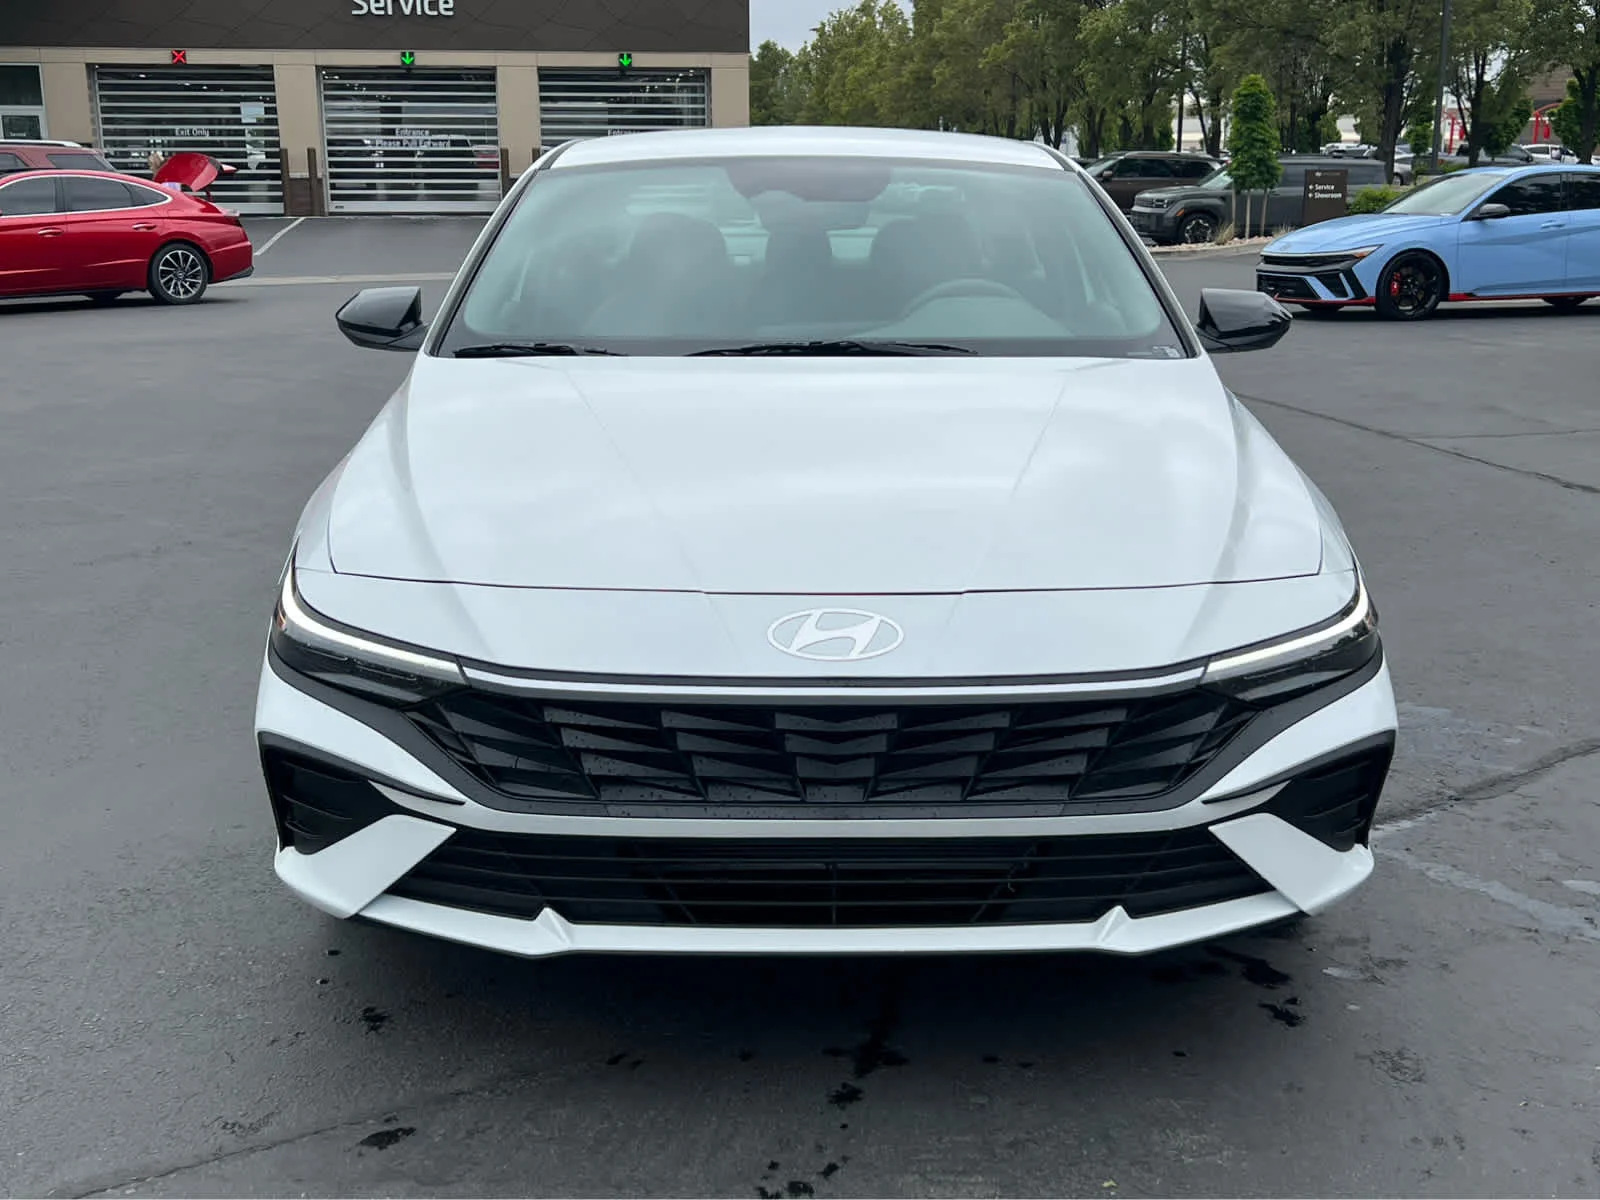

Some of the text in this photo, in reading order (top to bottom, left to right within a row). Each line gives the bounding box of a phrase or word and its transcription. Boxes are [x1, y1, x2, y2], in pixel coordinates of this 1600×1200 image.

[351, 0, 454, 16] Service
[192, 127, 210, 138] Only
[395, 127, 430, 137] Entrance
